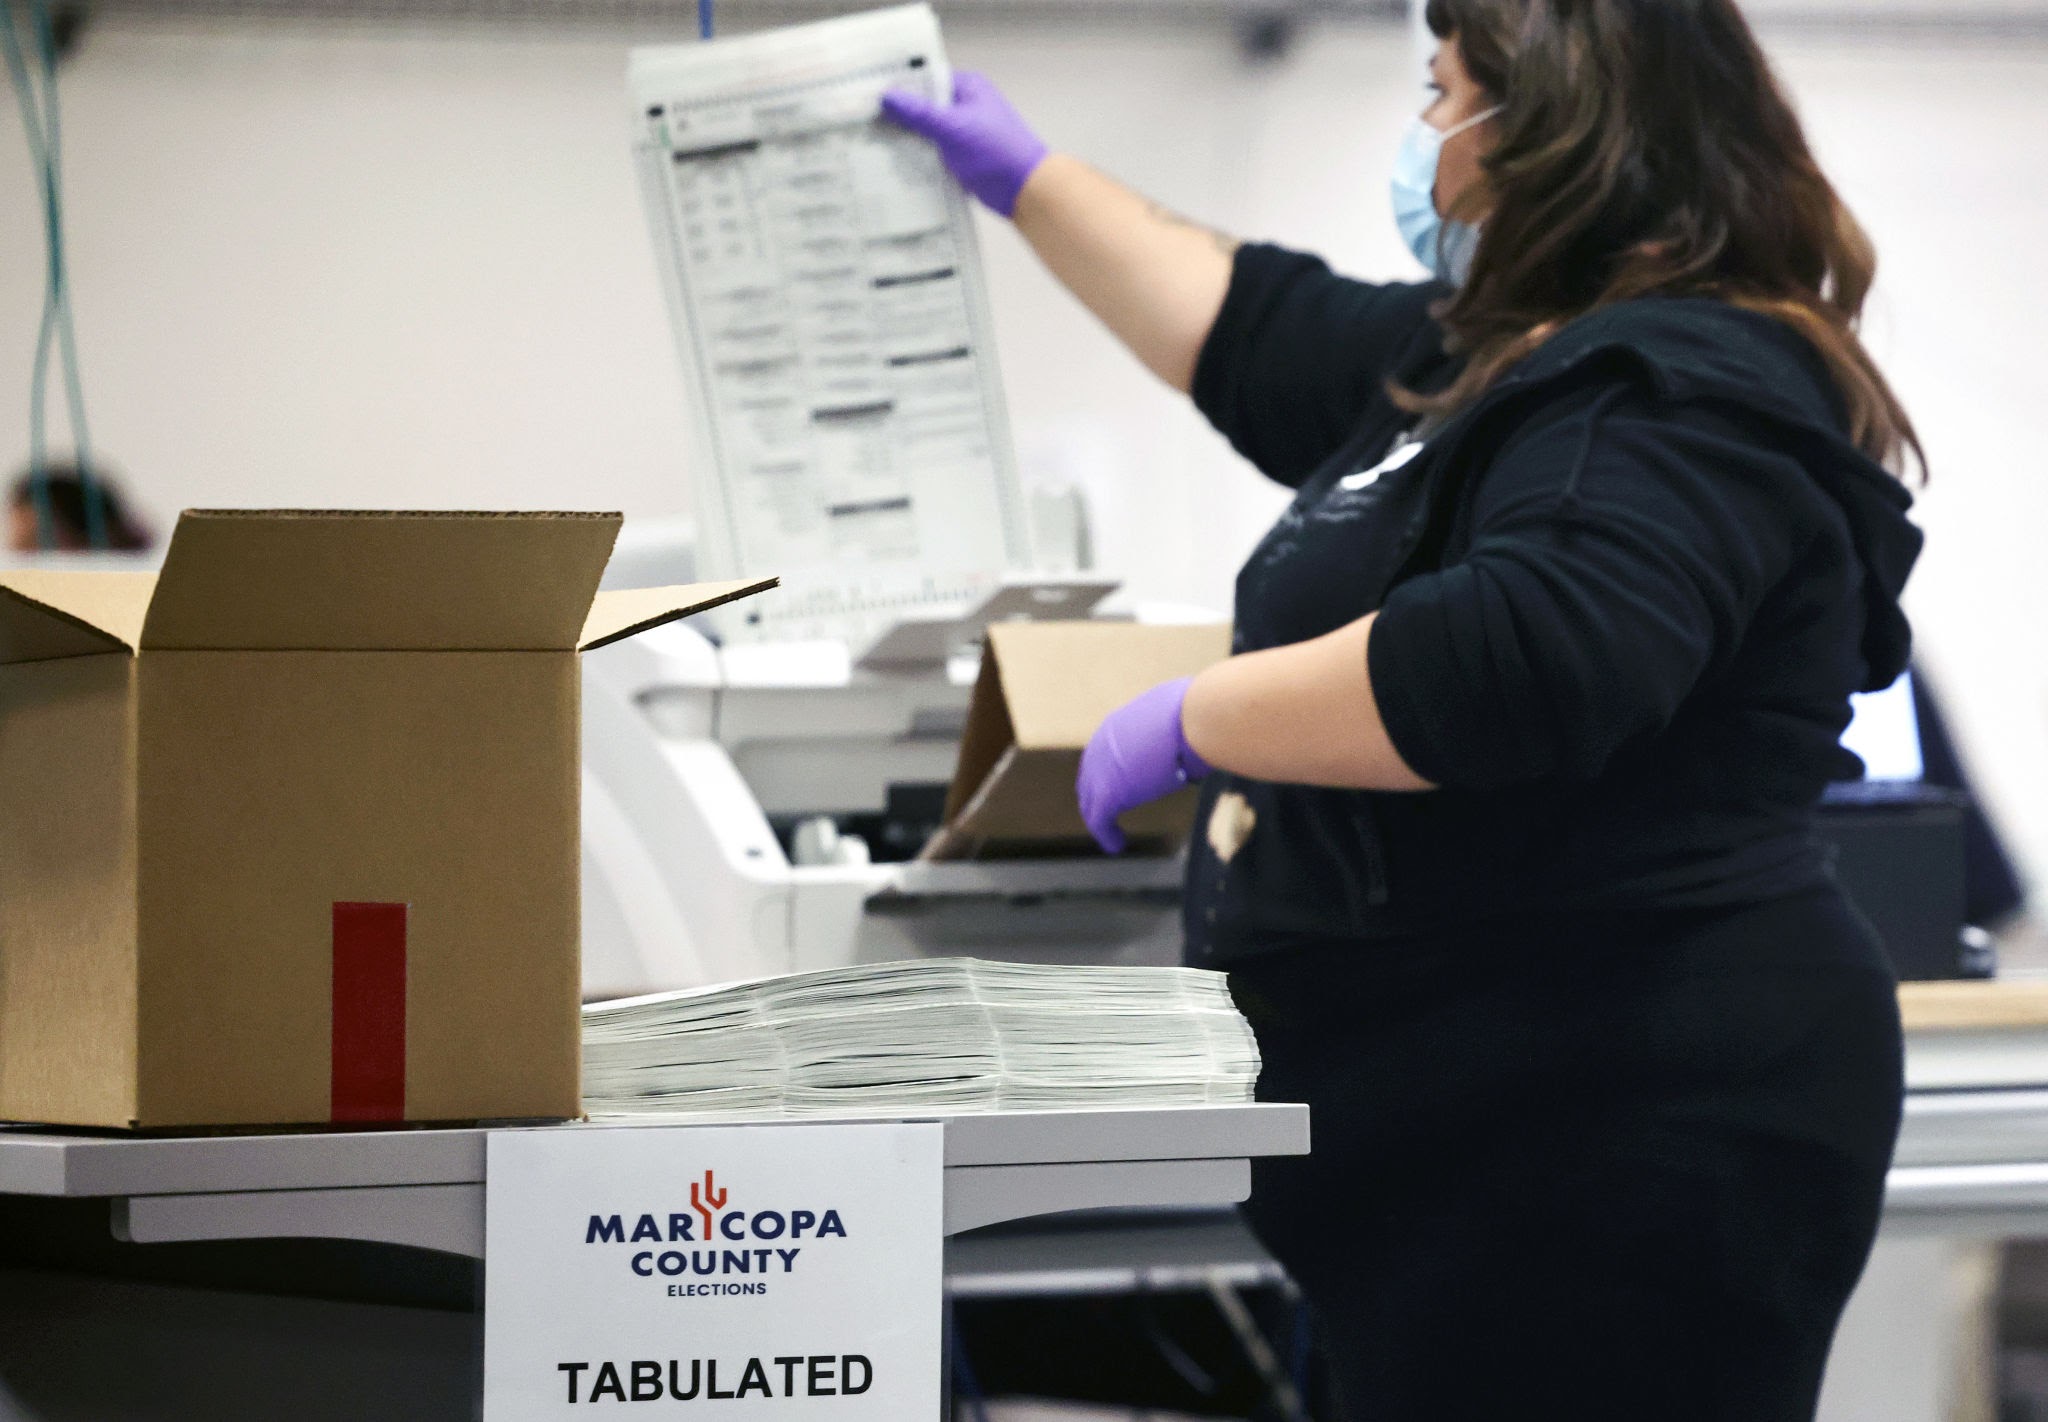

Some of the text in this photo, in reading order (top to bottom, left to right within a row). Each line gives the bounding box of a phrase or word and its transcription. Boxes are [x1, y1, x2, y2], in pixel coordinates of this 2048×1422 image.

[585, 1169, 848, 1244] MARICOPA
[630, 1248, 801, 1277] COUNTY
[667, 1282, 767, 1297] ELECTIONS
[557, 1354, 873, 1404] TABULATED
